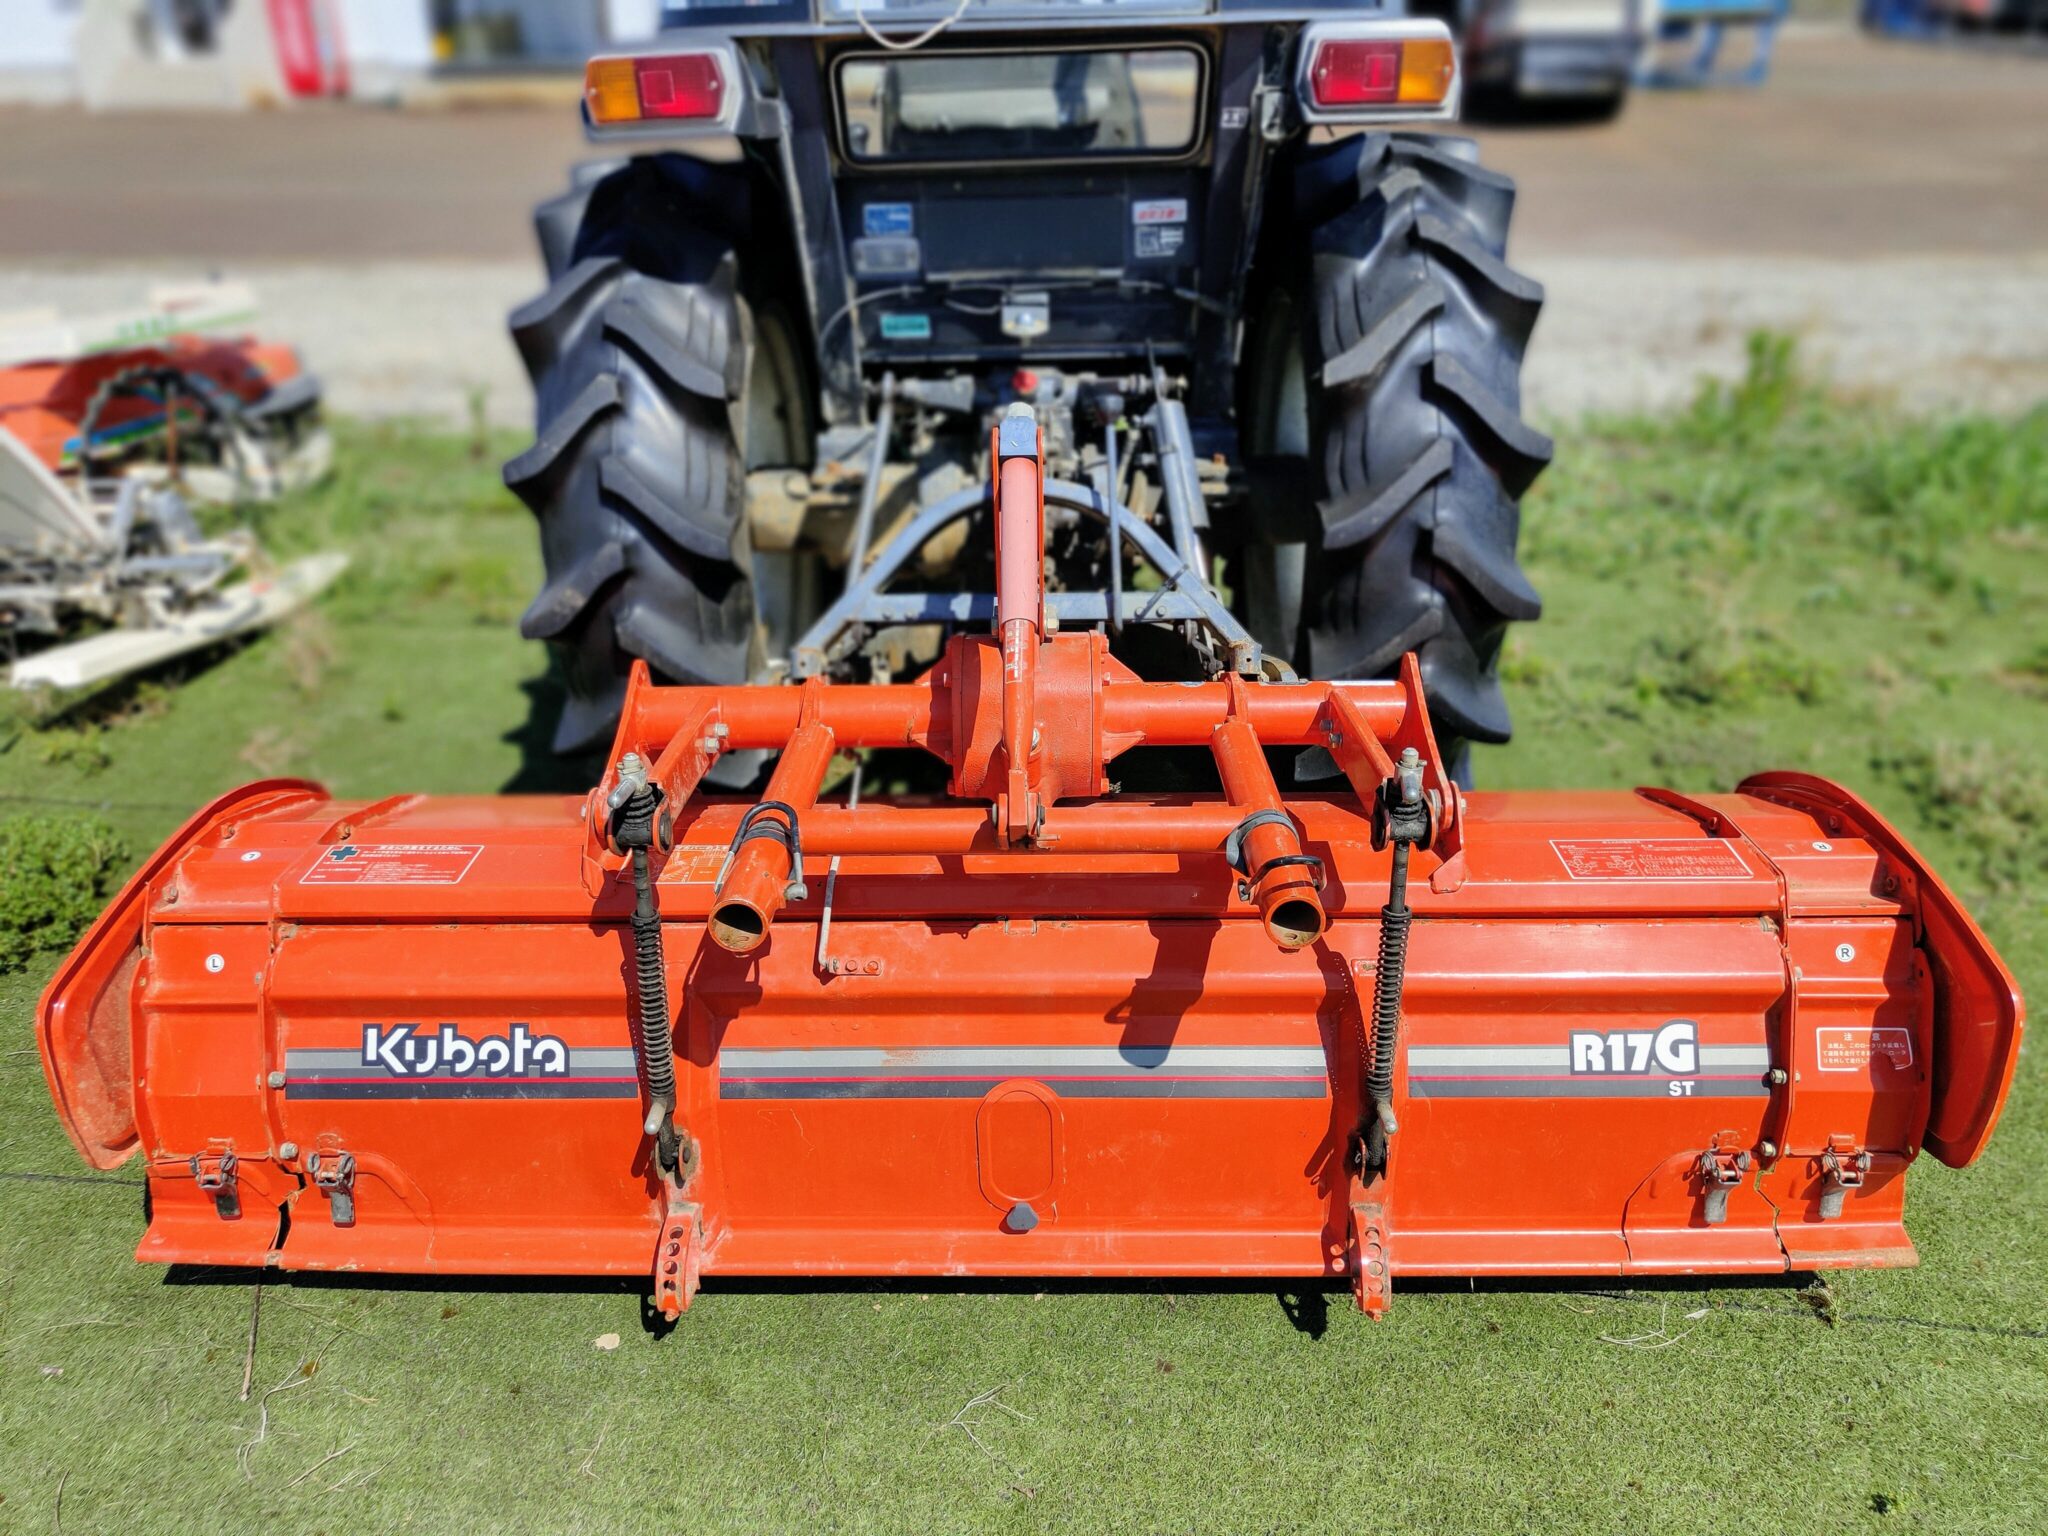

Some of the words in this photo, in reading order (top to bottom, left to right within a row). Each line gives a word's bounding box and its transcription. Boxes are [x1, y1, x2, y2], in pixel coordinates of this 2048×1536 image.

[365, 1026, 566, 1074] Kubota
[1572, 1023, 1695, 1073] R17G
[1669, 1081, 1695, 1097] ST
